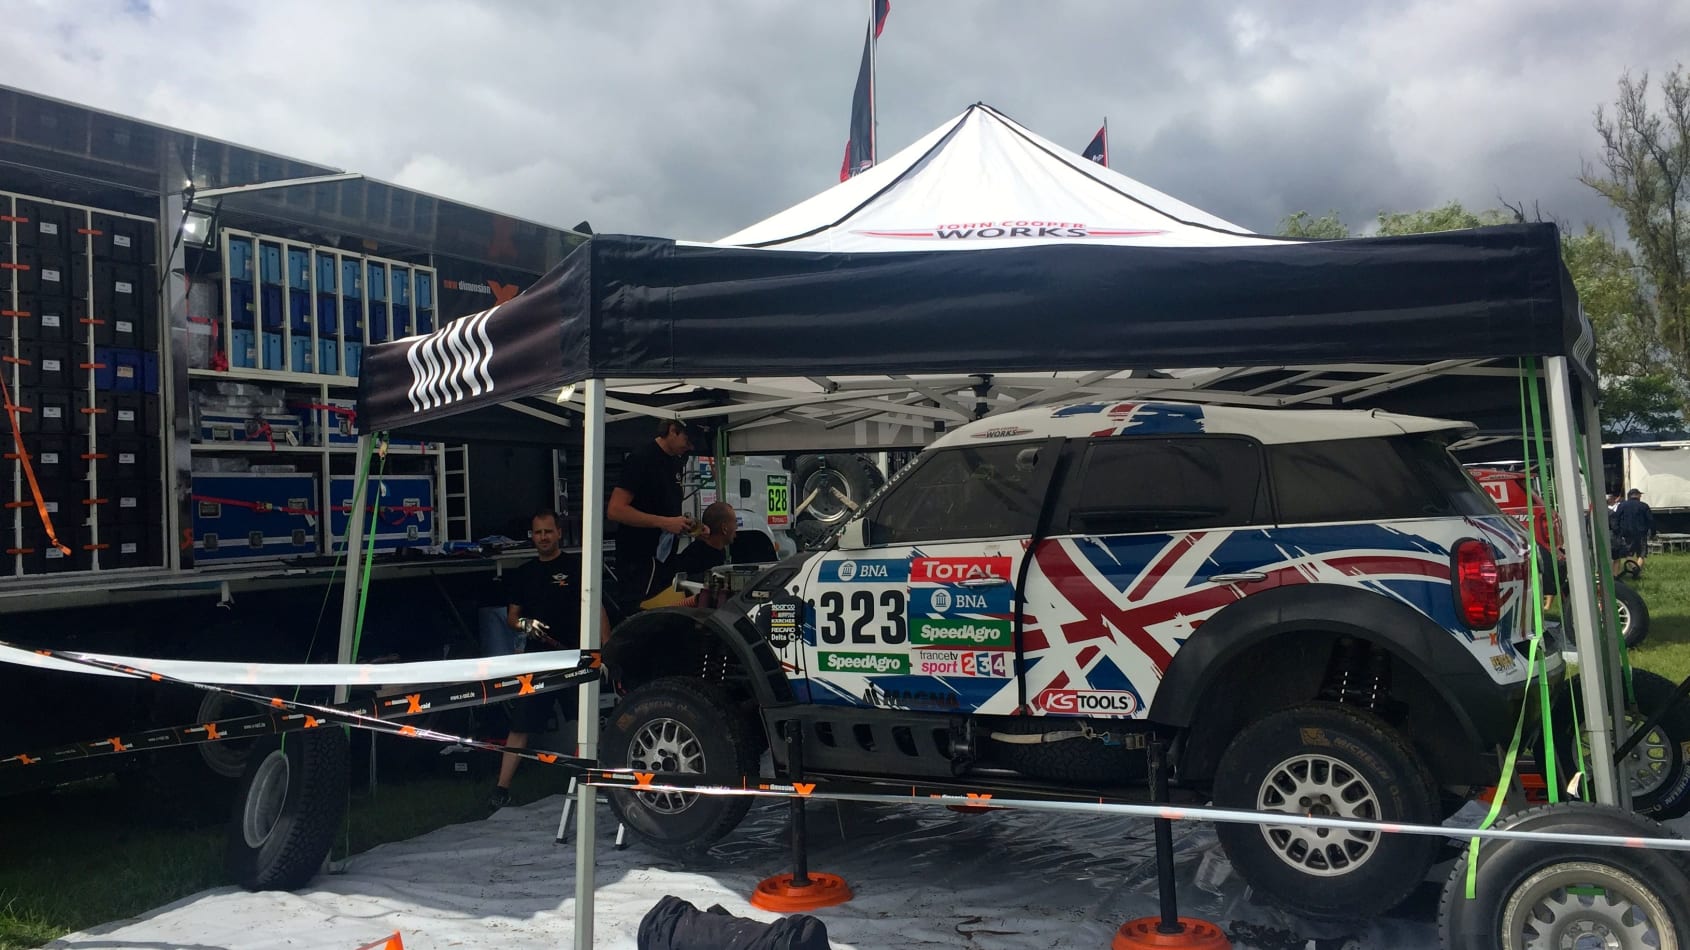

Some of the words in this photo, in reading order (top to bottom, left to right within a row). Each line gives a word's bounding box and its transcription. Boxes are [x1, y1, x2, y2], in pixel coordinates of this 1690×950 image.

[938, 222, 992, 230] JOHN
[1001, 220, 1085, 229] COOPER
[937, 227, 1087, 239] WORKS
[986, 430, 1017, 438] WORKS
[768, 489, 787, 512] 628
[859, 565, 888, 577] BNA
[922, 561, 1000, 579] TOTAL
[955, 595, 988, 608] BNA
[820, 590, 906, 645] 323
[920, 624, 1001, 643] SpeedAgro
[827, 653, 901, 672] SpeedAgro
[921, 661, 958, 675] sport
[1046, 693, 1077, 709] KS
[1077, 695, 1128, 709] TOOLS
